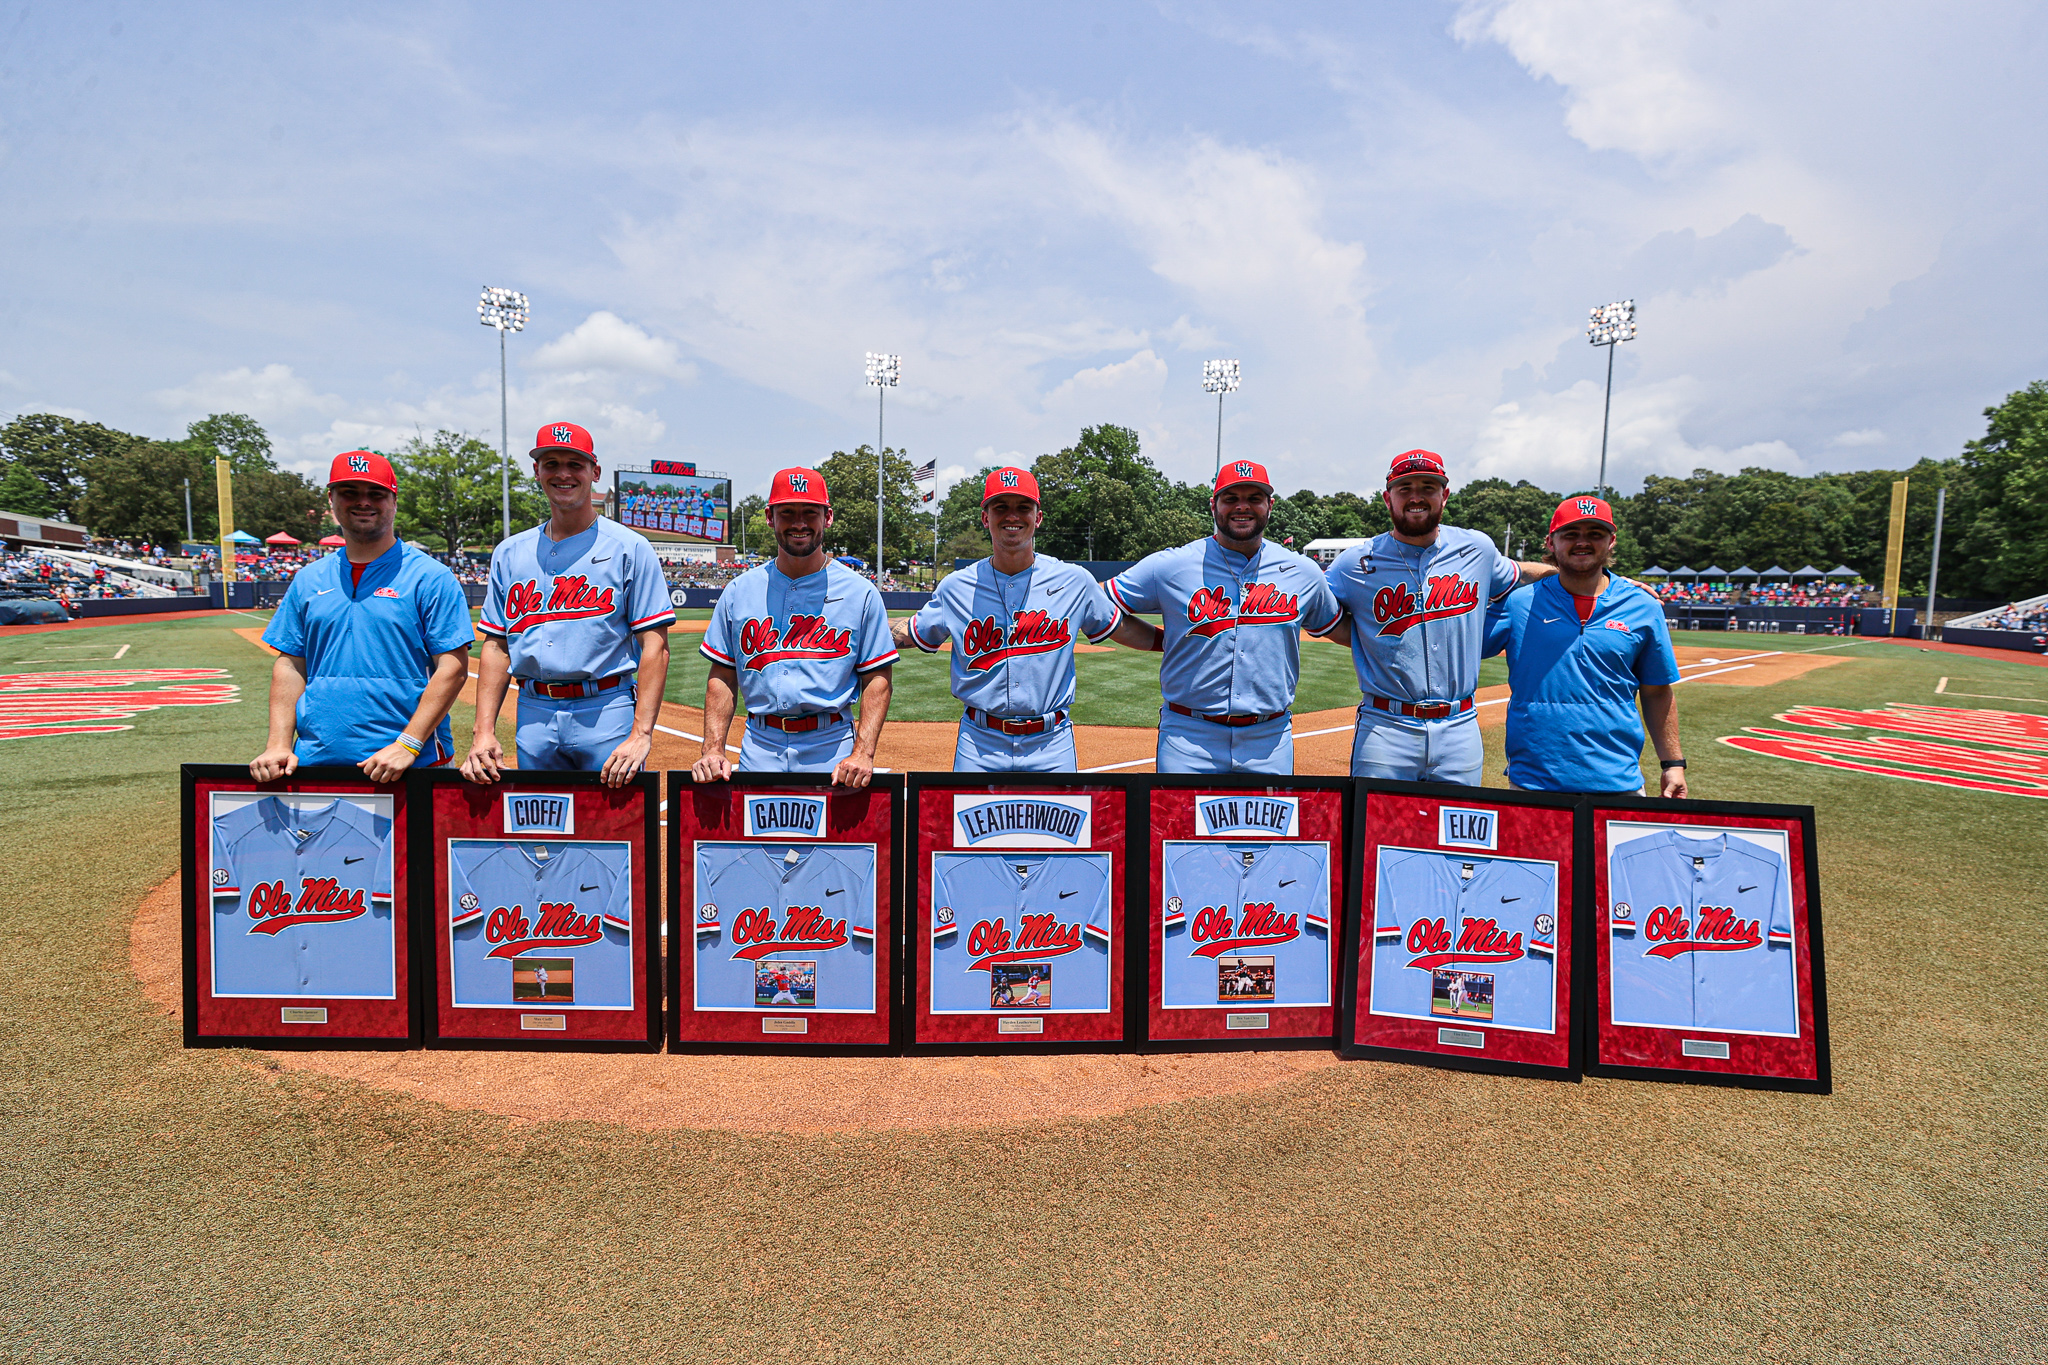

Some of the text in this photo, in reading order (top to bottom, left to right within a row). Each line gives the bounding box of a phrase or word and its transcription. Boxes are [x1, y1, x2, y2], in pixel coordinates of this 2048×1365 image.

[653, 460, 696, 476] Ole Miss
[1360, 555, 1377, 575] C
[505, 574, 616, 620] Ole Miss
[674, 595, 683, 603] 41
[1187, 581, 1299, 622] Ole Miss
[1373, 572, 1479, 624] Ole Miss
[741, 614, 851, 657] Ole Miss
[964, 608, 1071, 657] Ole Miss
[514, 799, 563, 827] CIOFFI
[755, 801, 817, 830] GADDIS
[964, 803, 1081, 838] LEATHERWOOD
[1205, 801, 1288, 830] VAN CLEVE
[1449, 814, 1488, 841] ELKO
[213, 869, 229, 885] SEC
[247, 877, 366, 920] Ole Miss
[460, 893, 478, 909] SEC
[701, 903, 718, 919] SEC
[1168, 896, 1182, 913] SEC
[1614, 902, 1631, 919] SEC
[485, 902, 602, 945] Ole Miss
[731, 905, 848, 946] Ole Miss
[938, 907, 953, 923] SEC
[1190, 901, 1300, 943] Ole Miss
[1536, 914, 1554, 934] SEC
[1645, 905, 1763, 944] Ole Miss
[966, 913, 1083, 957] Ole Miss
[1406, 917, 1523, 955] Ole Miss
